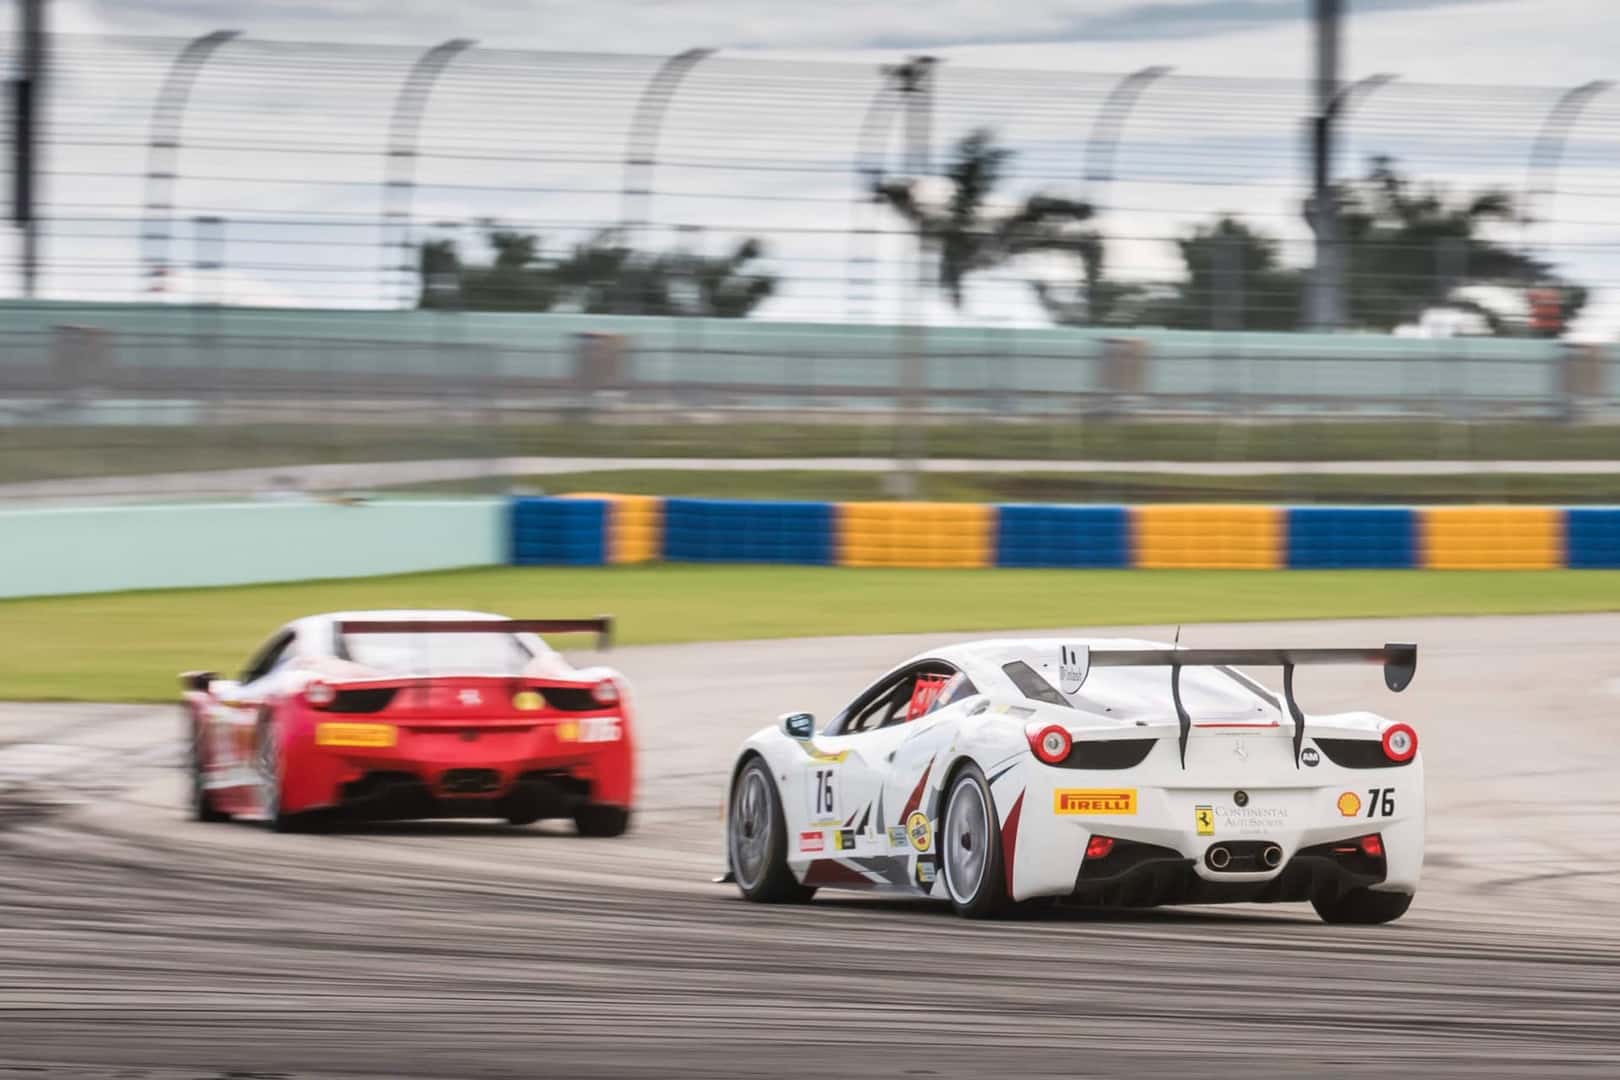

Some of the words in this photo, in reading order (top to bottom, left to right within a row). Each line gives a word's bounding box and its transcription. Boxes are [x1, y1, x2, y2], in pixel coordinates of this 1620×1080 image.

[817, 770, 832, 813] 76
[1061, 794, 1130, 809] PIRELLI
[1367, 788, 1395, 817] 76
